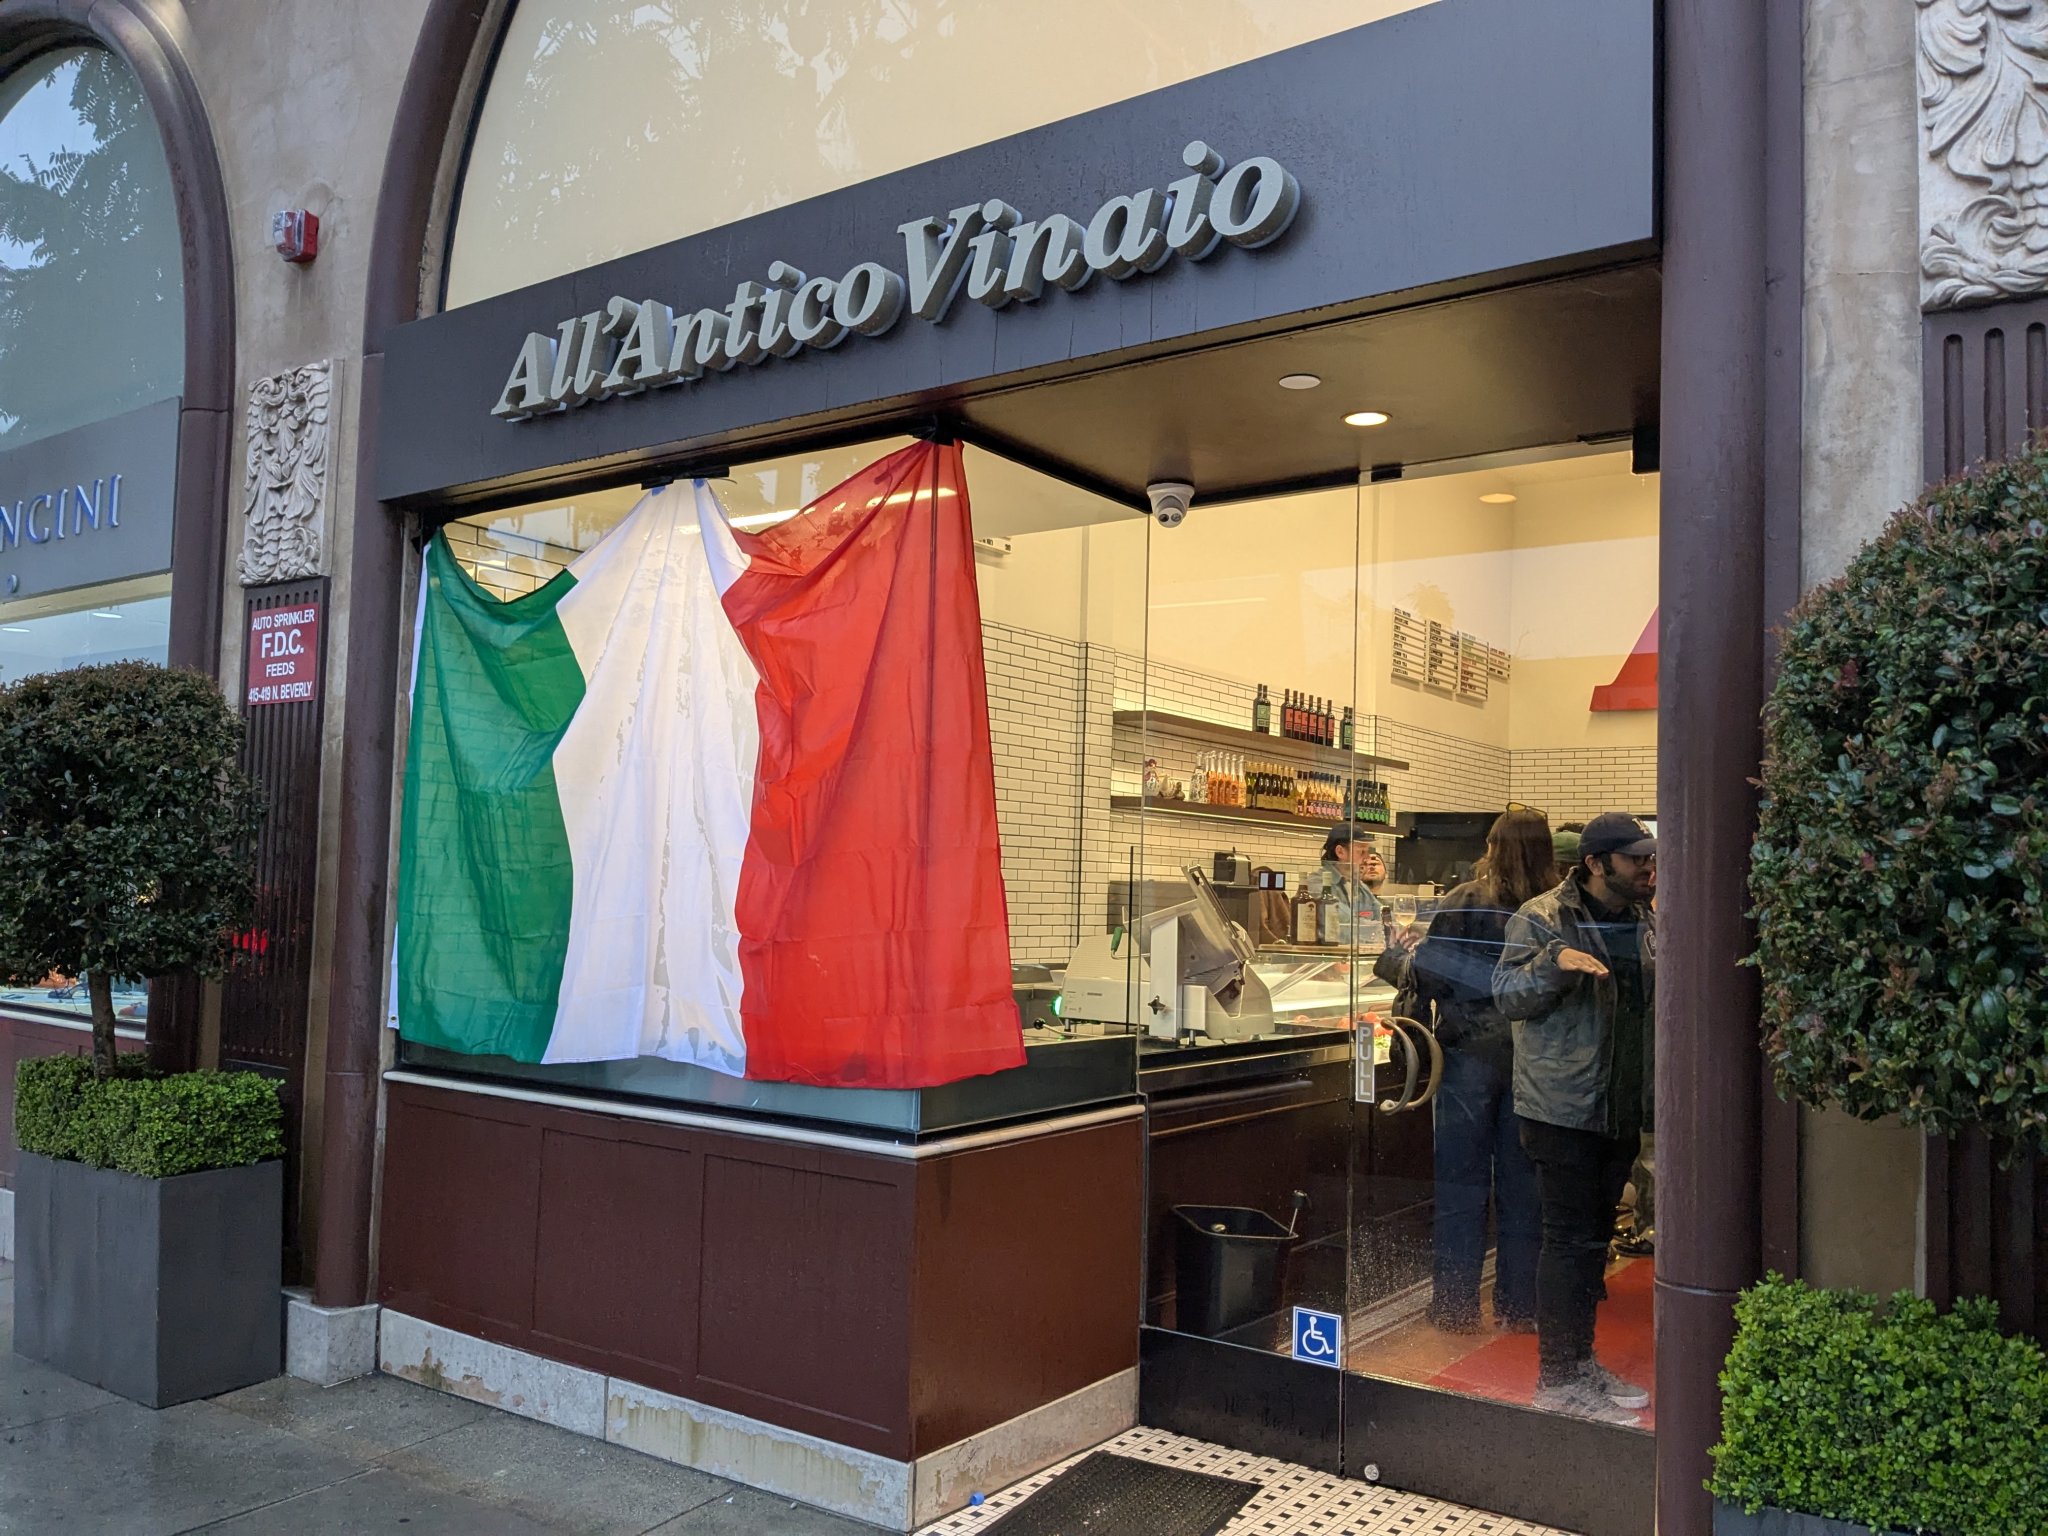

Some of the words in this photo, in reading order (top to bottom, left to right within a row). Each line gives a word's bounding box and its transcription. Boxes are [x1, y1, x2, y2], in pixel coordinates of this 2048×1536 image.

[491, 261, 905, 422] All'Antico
[897, 140, 1301, 324] Vinaio
[252, 616, 272, 631] AUTO
[274, 609, 315, 627] SPRINKLER
[261, 629, 304, 658] F.D.C.
[266, 661, 295, 677] FEEDS
[281, 681, 312, 699] BEVERLY
[1359, 1026, 1371, 1097] PULL
